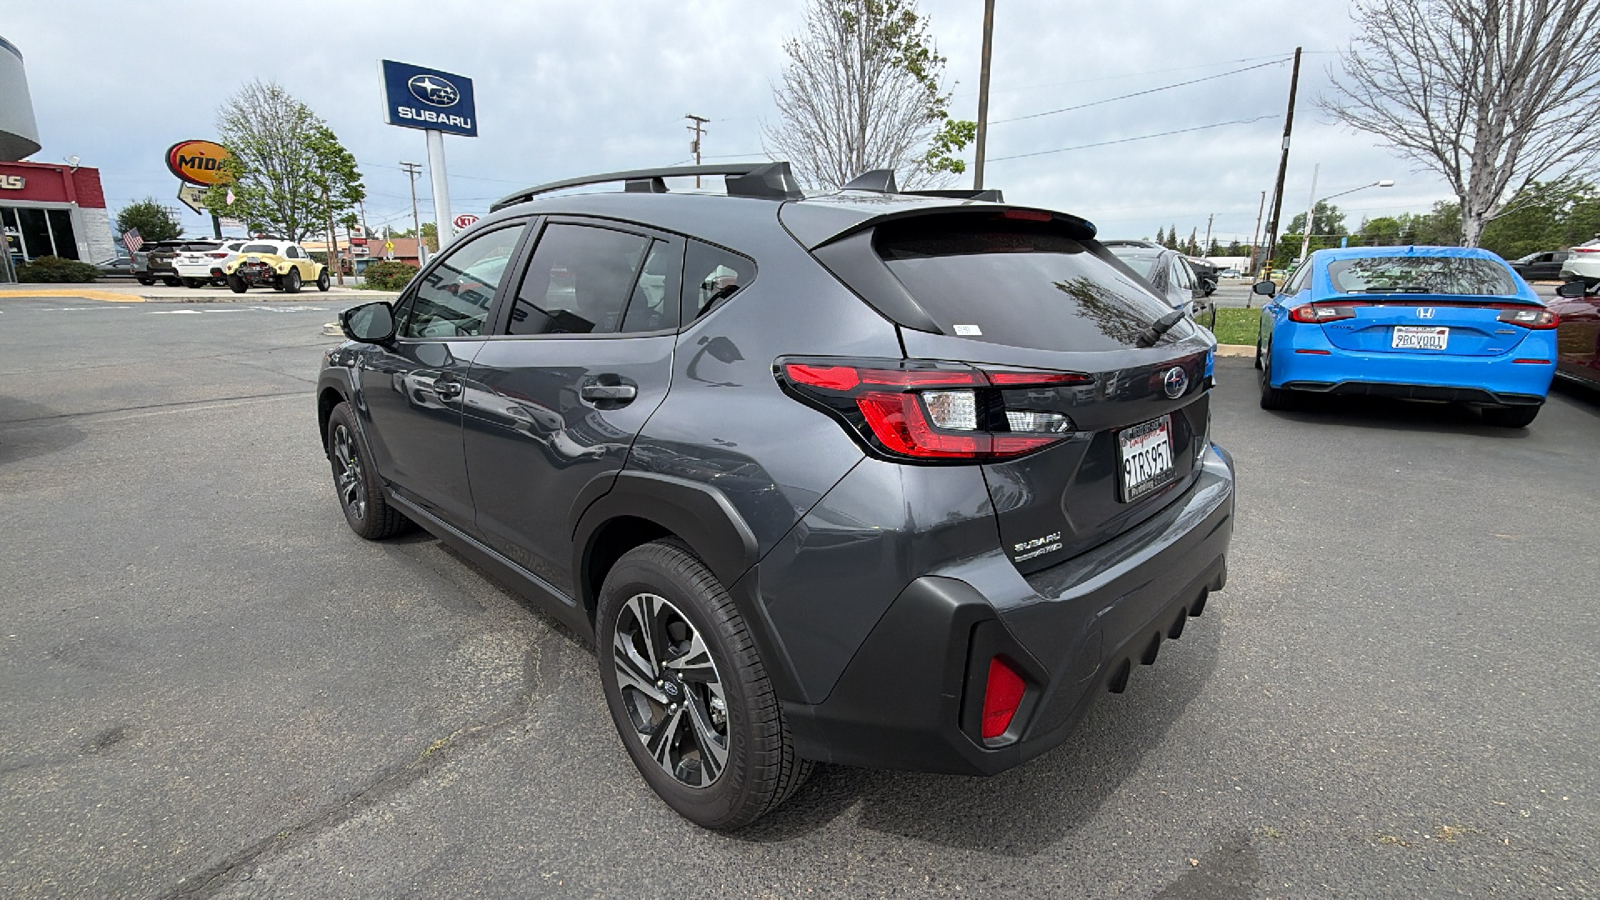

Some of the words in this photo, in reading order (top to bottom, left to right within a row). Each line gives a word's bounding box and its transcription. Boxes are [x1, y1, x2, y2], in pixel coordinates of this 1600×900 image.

[397, 106, 472, 129] SUBARU
[178, 154, 227, 173] MID
[1124, 440, 1169, 489] 9TRS957
[1014, 531, 1061, 552] SUBARU
[731, 700, 747, 789] YOKOHAMA
